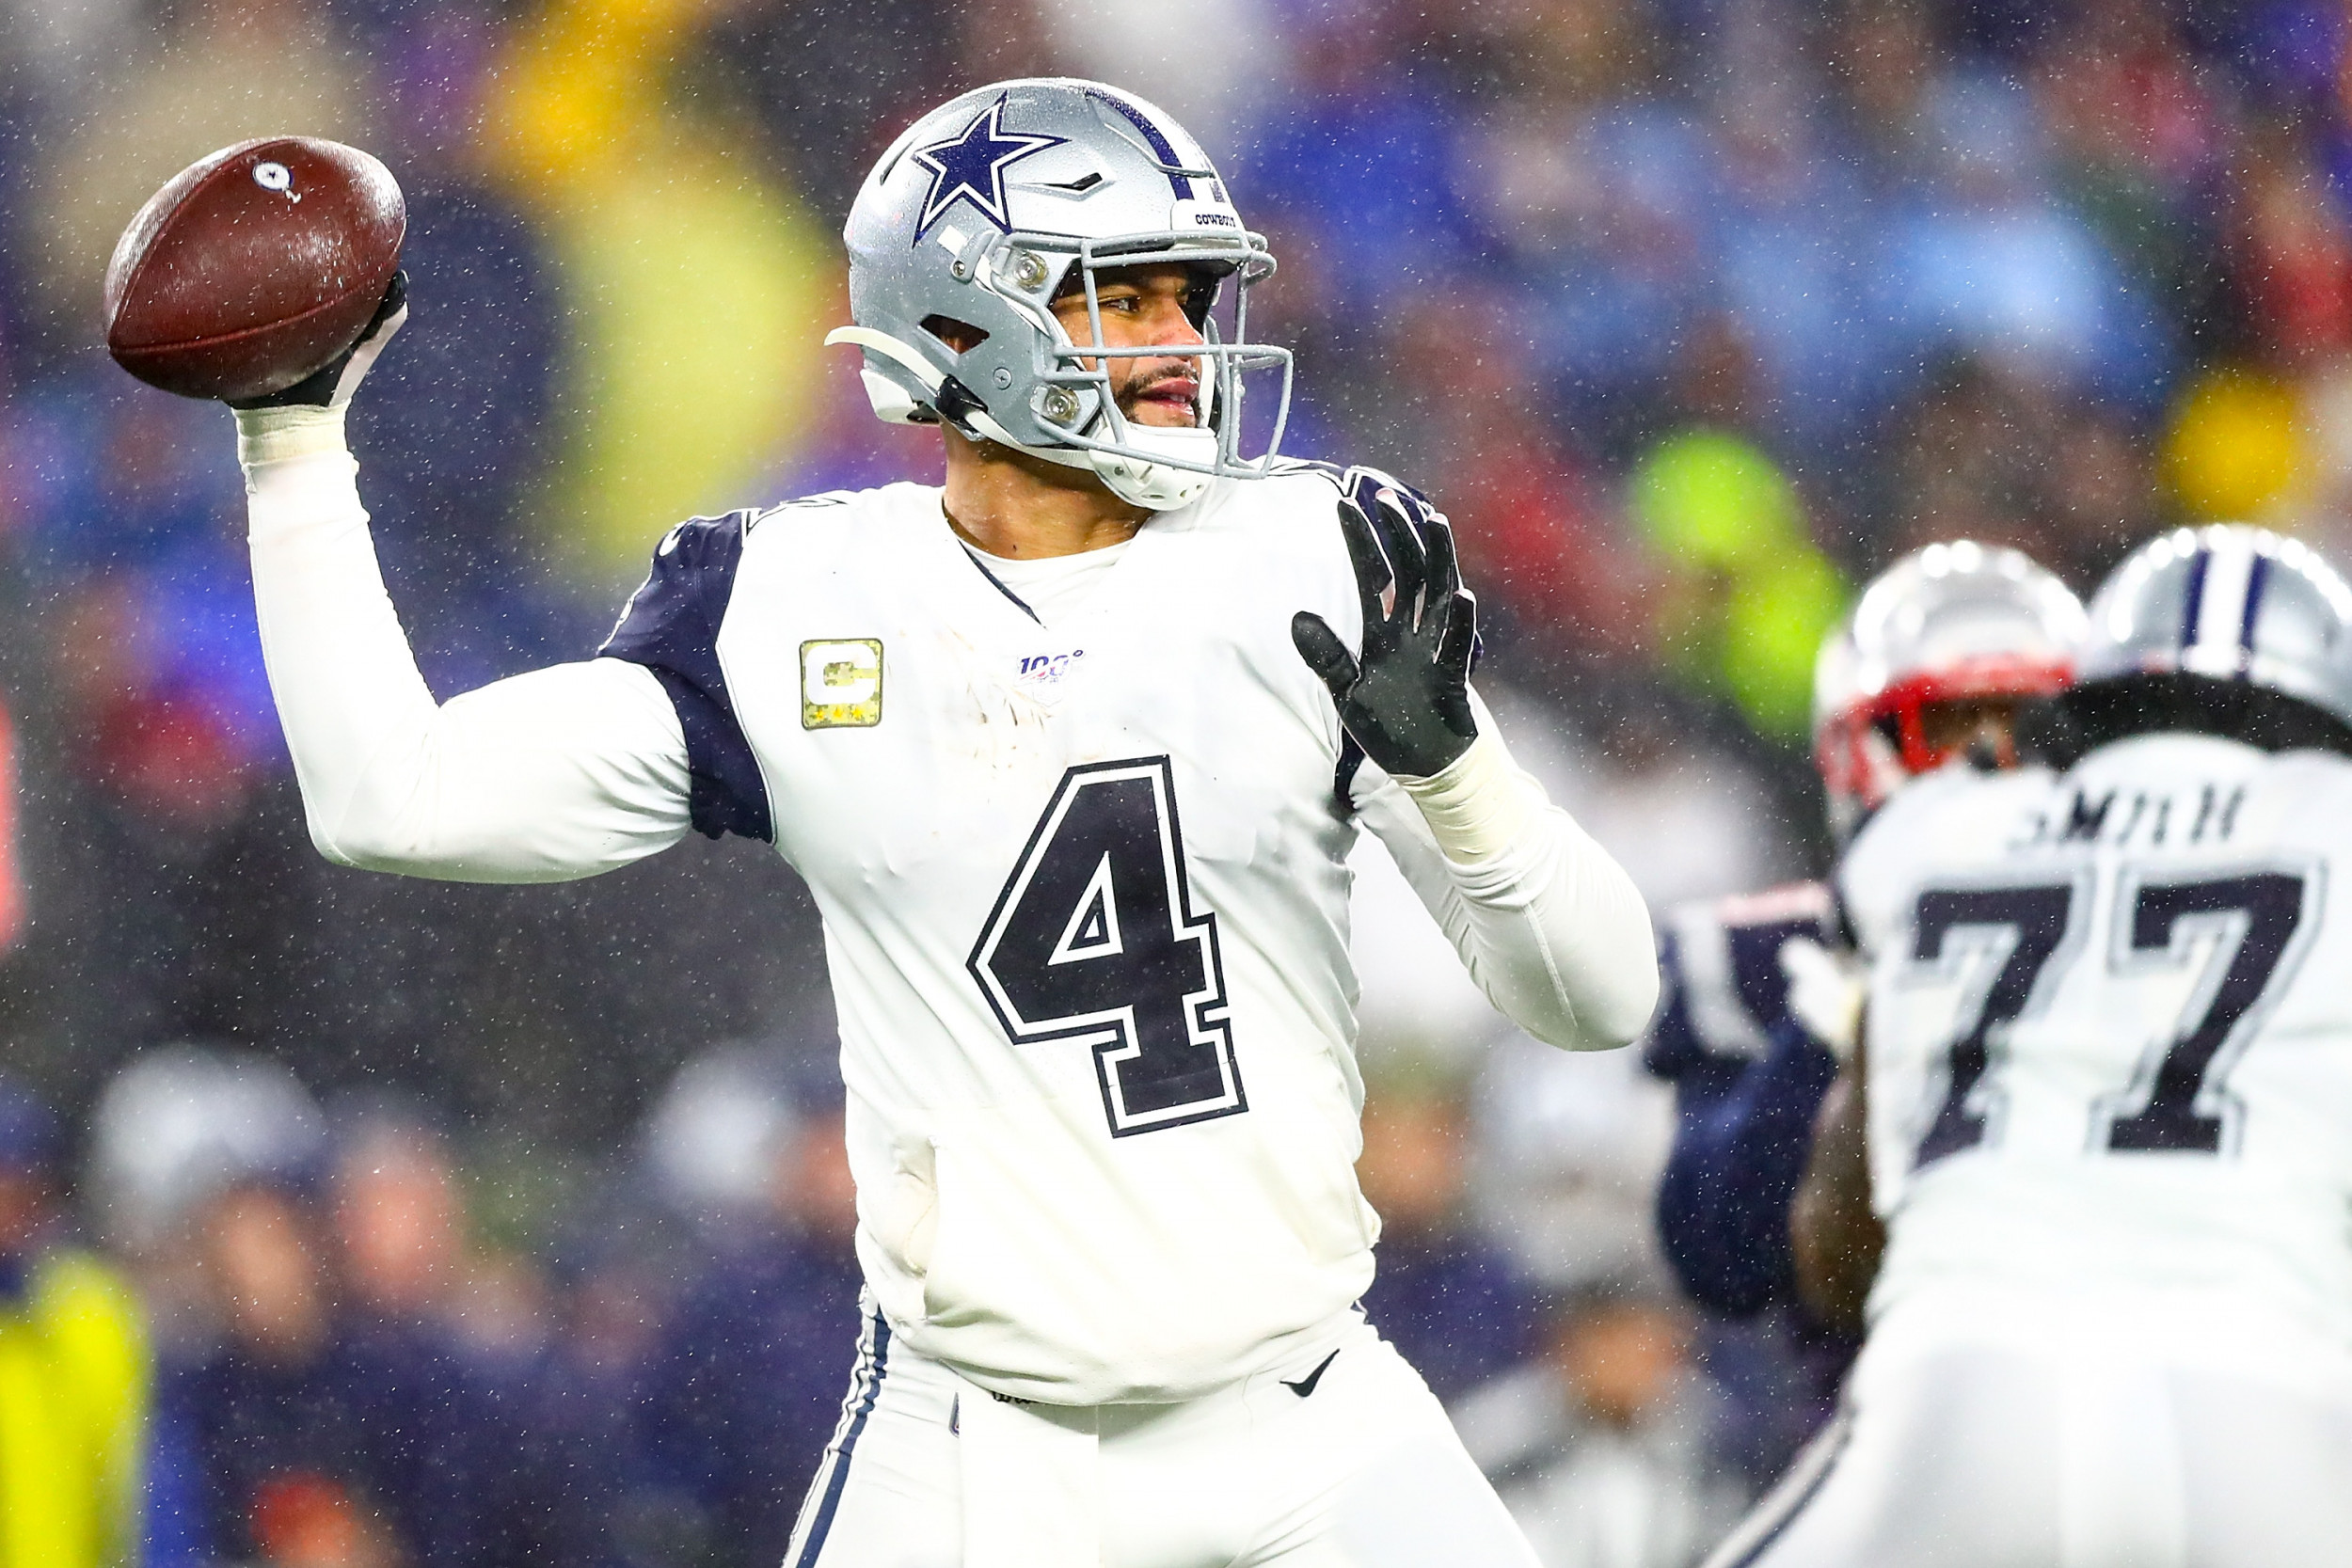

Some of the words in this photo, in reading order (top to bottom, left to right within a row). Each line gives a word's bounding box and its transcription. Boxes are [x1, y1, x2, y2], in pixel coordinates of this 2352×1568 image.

[803, 641, 878, 704] C
[966, 754, 1248, 1137] 4
[1908, 867, 2318, 1169] 77
